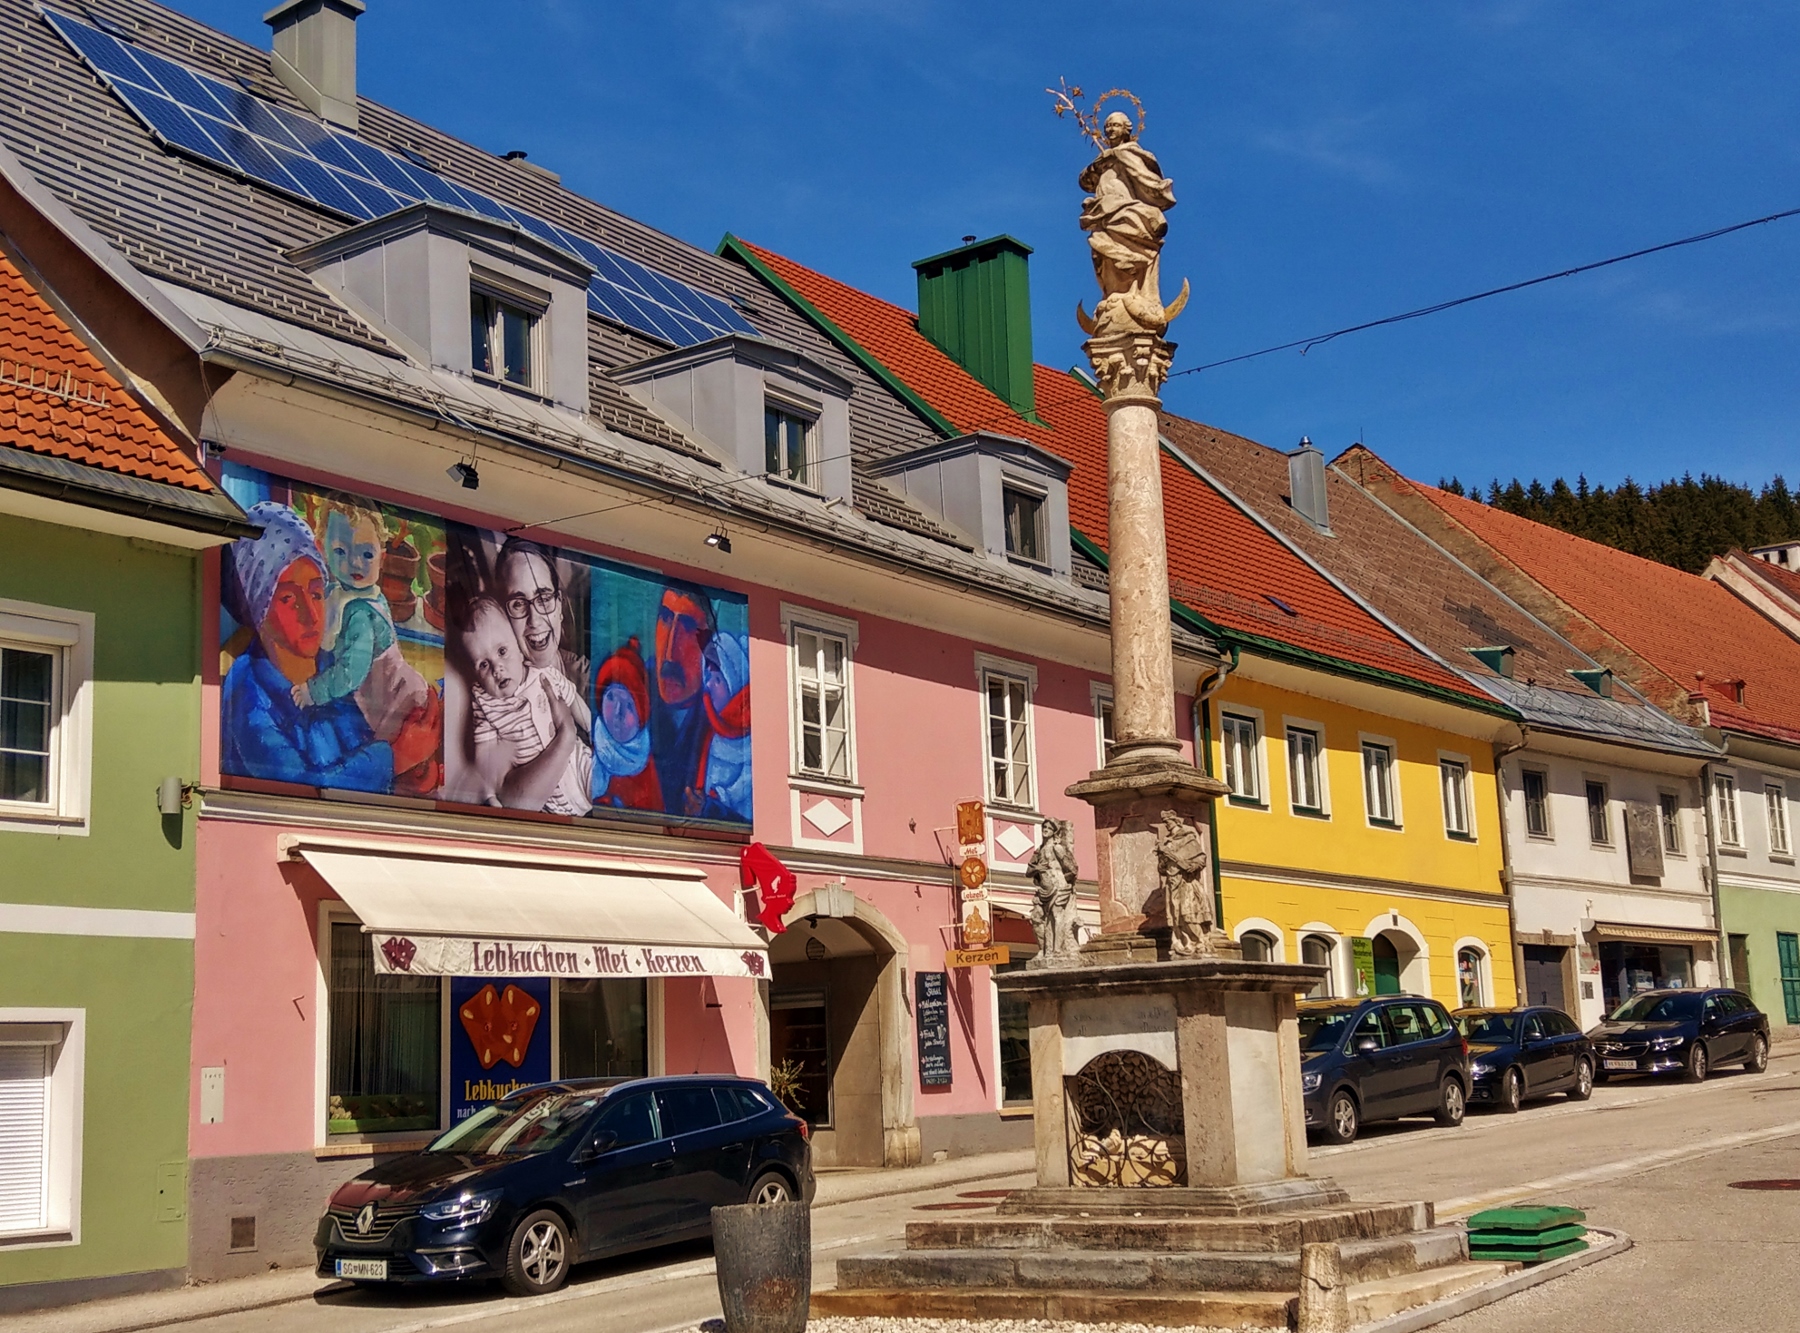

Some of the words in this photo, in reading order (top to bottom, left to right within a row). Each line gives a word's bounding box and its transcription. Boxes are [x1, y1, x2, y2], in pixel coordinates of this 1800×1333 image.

[472, 941, 581, 974] Lebkuchen
[592, 946, 633, 974] Met
[641, 948, 708, 974] Kerzen
[956, 952, 999, 964] Kerzen
[464, 1078, 535, 1101] Lebkuch
